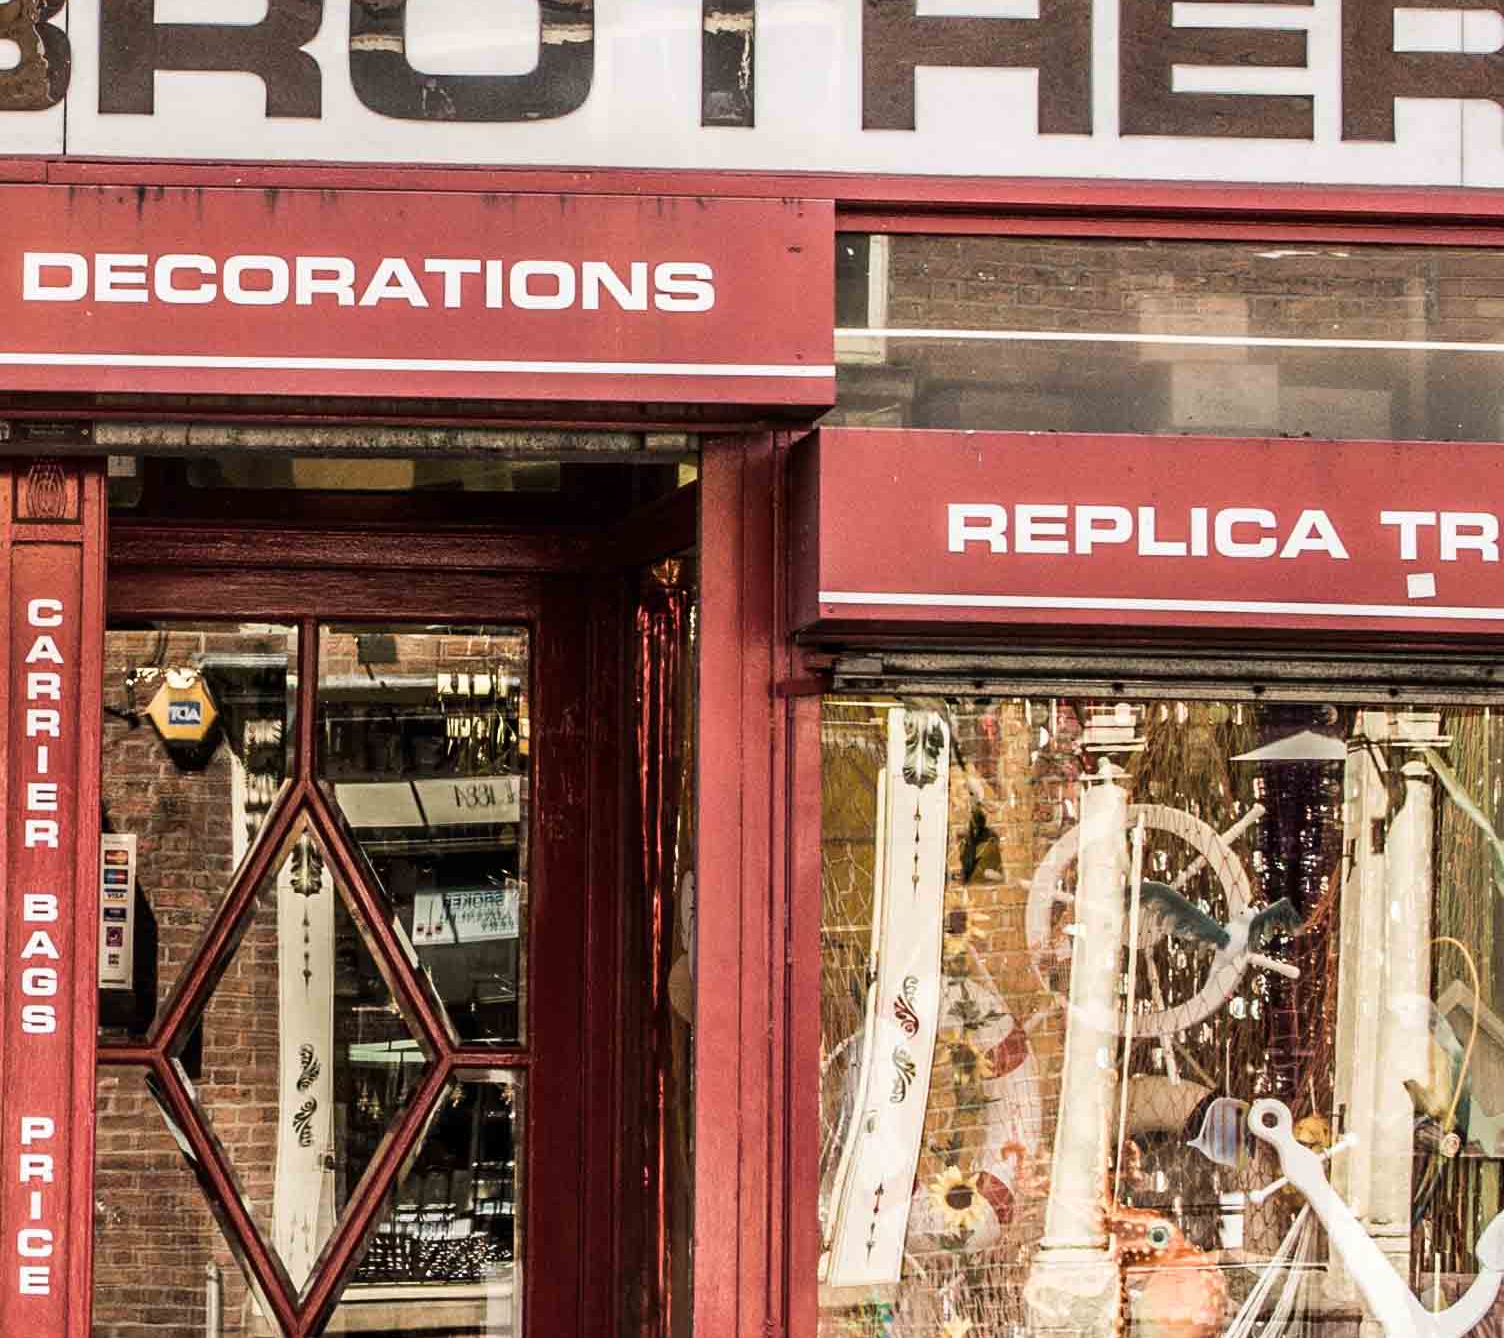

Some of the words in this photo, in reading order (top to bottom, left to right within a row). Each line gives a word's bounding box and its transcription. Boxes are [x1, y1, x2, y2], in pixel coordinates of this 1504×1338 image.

[21, 251, 717, 314] DECORATIONS
[946, 502, 1351, 560] REPLICA
[23, 597, 66, 849] CARRIER
[19, 892, 61, 1035] BAGS
[16, 1115, 56, 1296] PRICE
